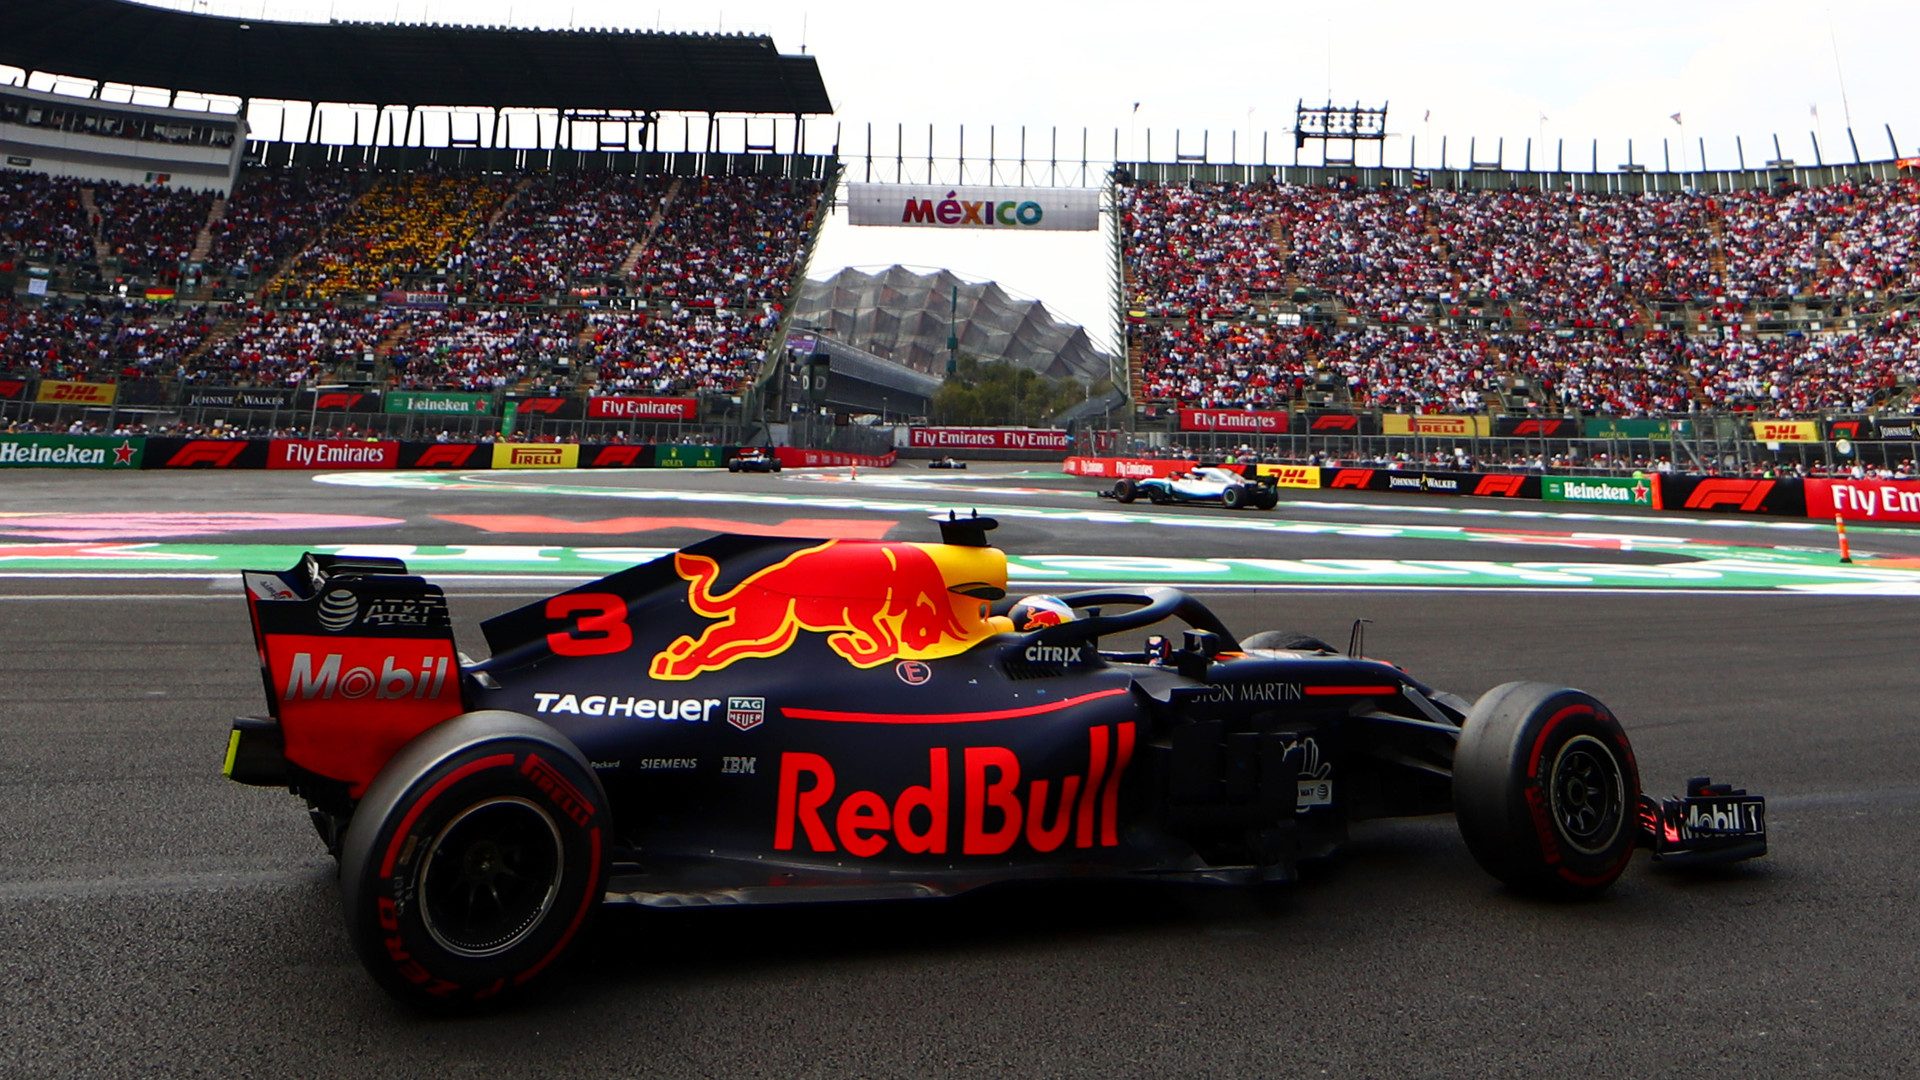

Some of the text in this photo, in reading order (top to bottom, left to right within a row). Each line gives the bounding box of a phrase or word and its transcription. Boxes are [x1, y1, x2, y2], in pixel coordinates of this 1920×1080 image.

[188, 393, 285, 406] JOHNNIE WALKER
[406, 397, 469, 412] Heineken
[602, 400, 684, 416] Fly Emirates
[1194, 413, 1276, 428] Fly Emirates
[1407, 417, 1465, 433] PIRELLI
[914, 430, 995, 447] Fly Emirates
[1004, 432, 1027, 447] Fly
[1764, 425, 1801, 440] DHL
[0, 442, 105, 464] Heineken
[286, 443, 384, 465] Fly Emirates
[510, 447, 563, 465] PIRELLI
[1389, 475, 1457, 489] JOHNNIE WALKER
[1563, 481, 1629, 501] Heineken
[1831, 484, 1875, 516] Fly
[545, 593, 633, 657] 3
[284, 653, 449, 701] Mobil
[1240, 682, 1301, 701] MARTIN
[732, 700, 762, 709] TAG
[730, 711, 763, 726] HEUER
[640, 758, 697, 770] SIEMENS
[721, 756, 757, 774] IBM
[774, 721, 1136, 858] Red Bull
[1681, 803, 1740, 840] Mobil
